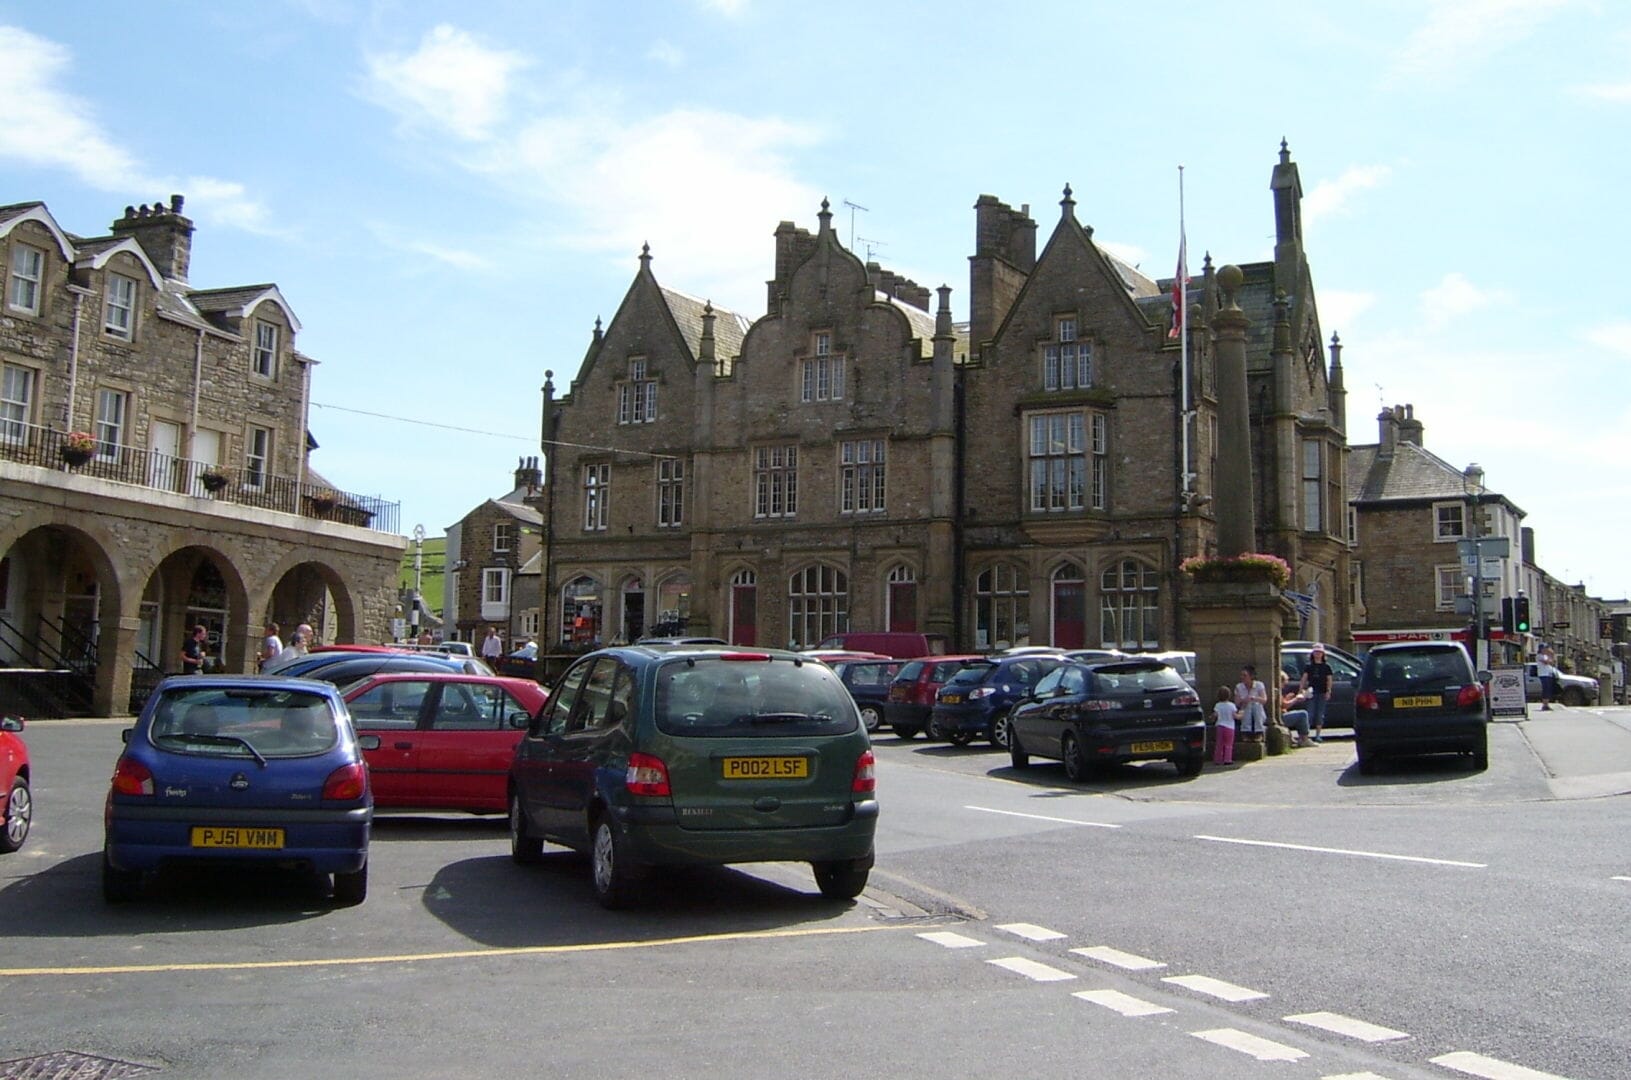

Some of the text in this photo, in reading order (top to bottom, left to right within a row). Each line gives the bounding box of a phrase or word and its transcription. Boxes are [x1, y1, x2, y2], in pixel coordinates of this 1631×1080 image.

[1387, 632, 1429, 640] SPAR
[773, 760, 802, 775] LSF
[203, 830, 277, 845] PJ51 VMM
